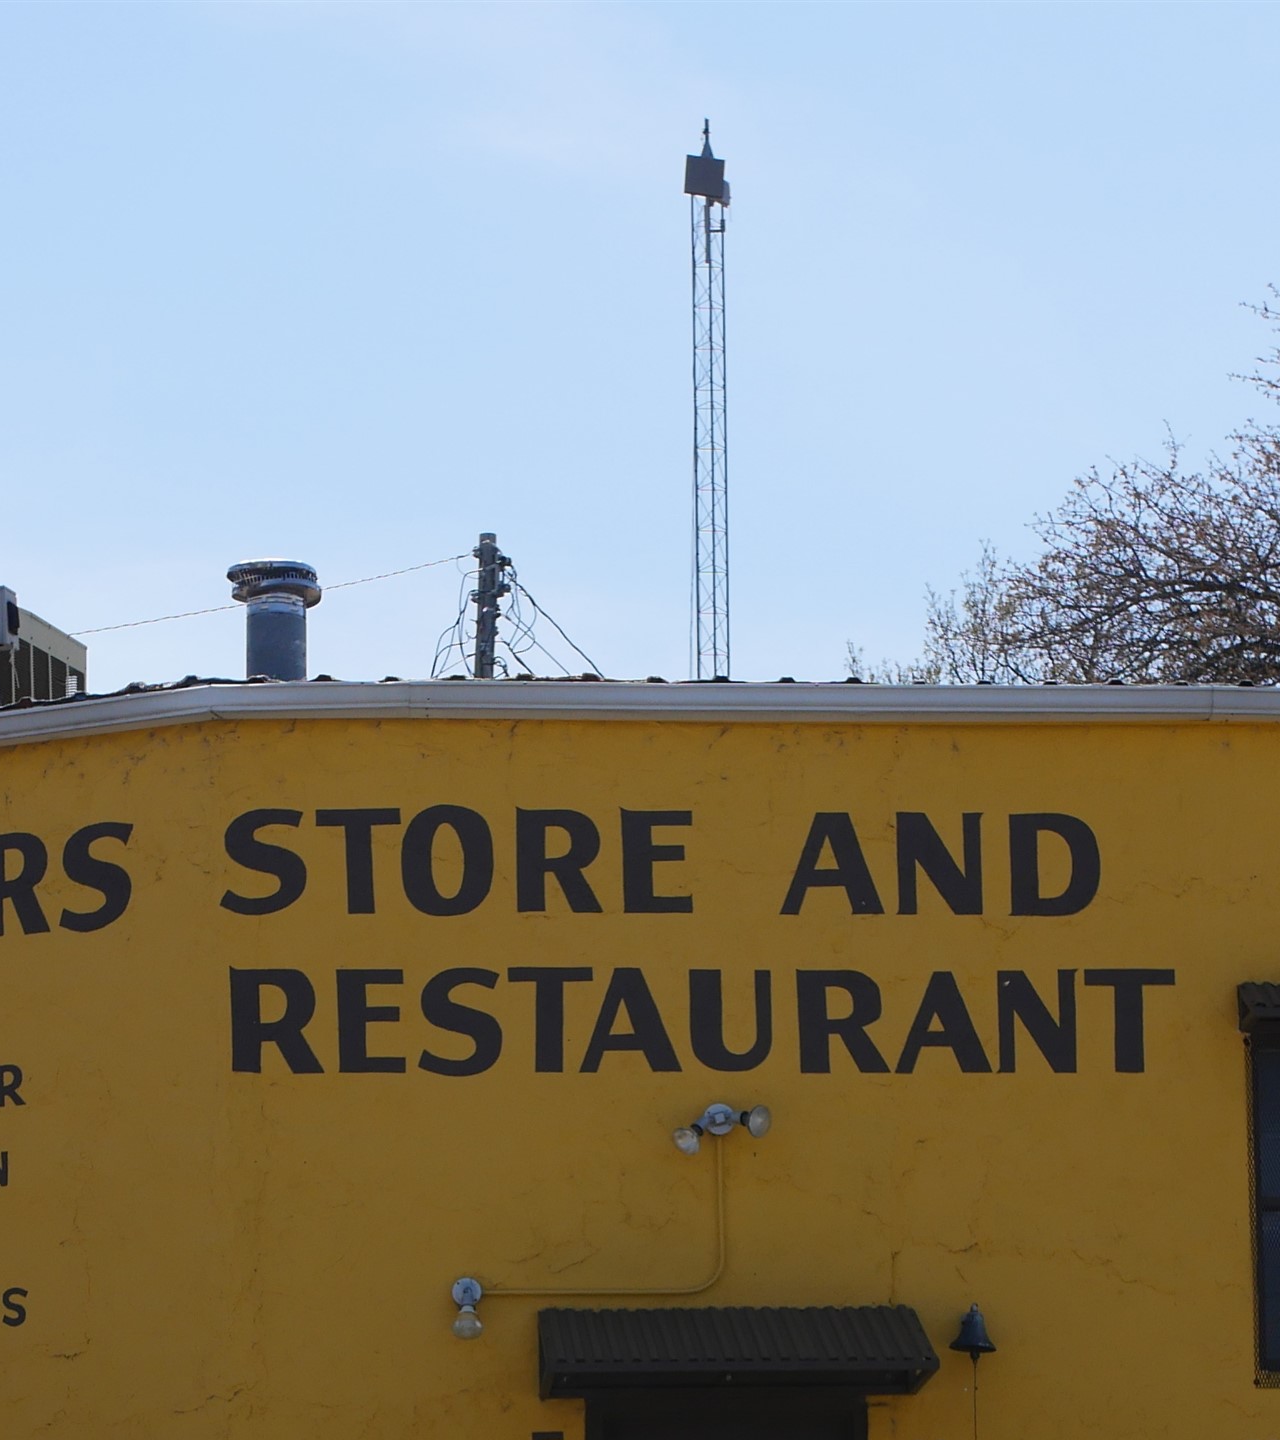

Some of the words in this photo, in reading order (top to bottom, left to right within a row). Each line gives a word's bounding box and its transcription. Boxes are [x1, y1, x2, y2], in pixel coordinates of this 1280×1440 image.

[220, 804, 693, 916] STORE
[781, 812, 1101, 916] AND
[229, 966, 1176, 1076] RESTAURANT
